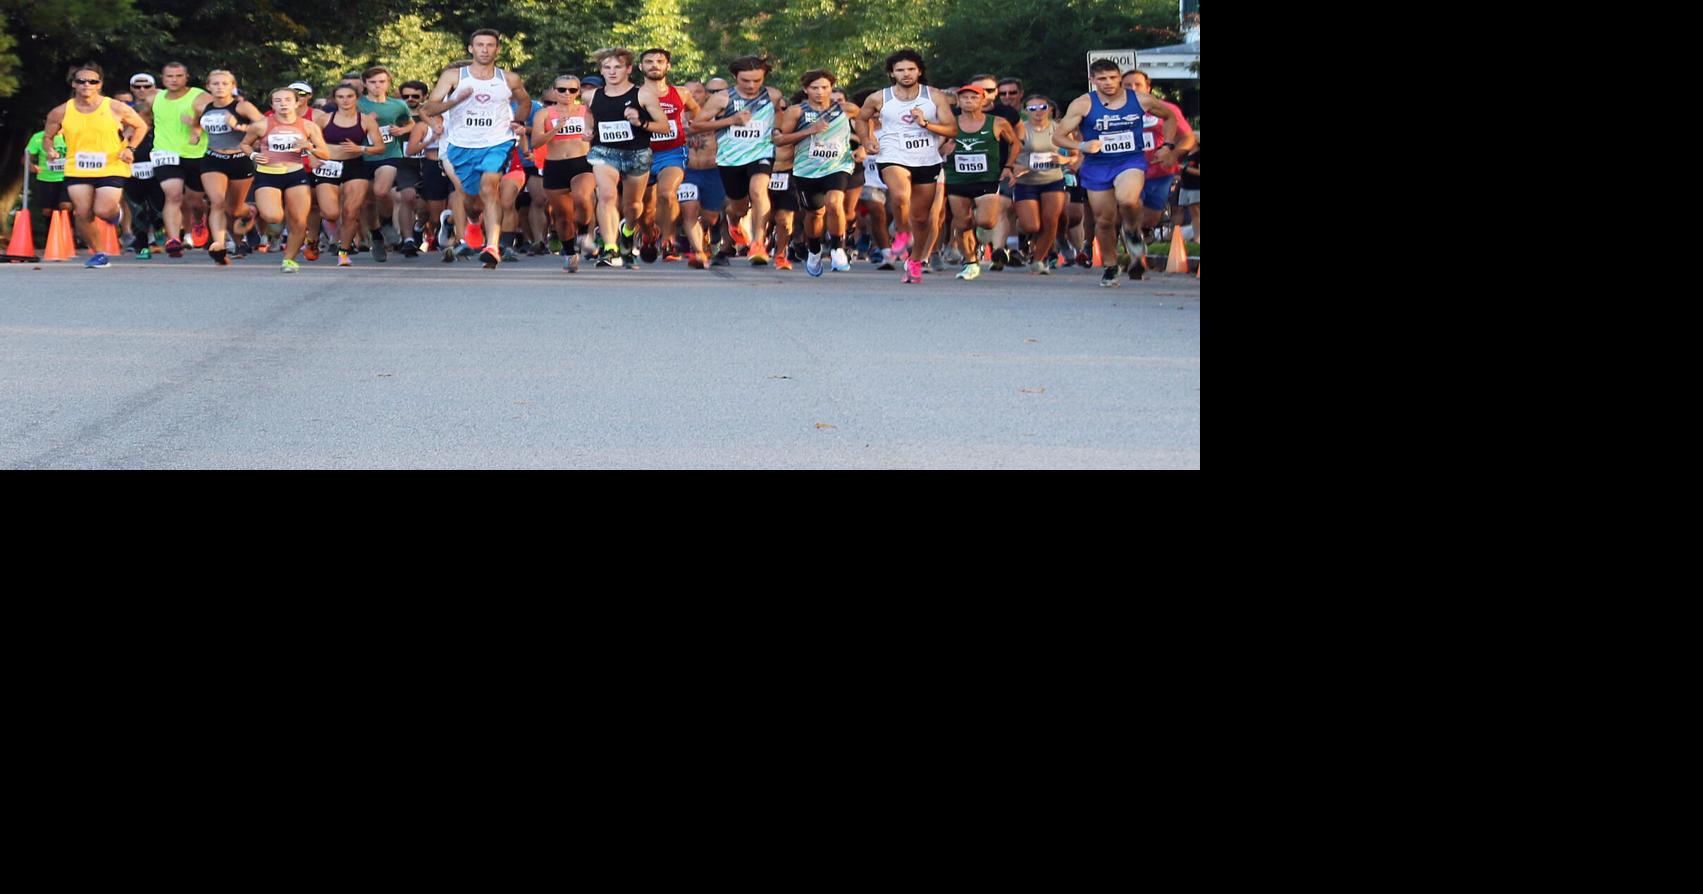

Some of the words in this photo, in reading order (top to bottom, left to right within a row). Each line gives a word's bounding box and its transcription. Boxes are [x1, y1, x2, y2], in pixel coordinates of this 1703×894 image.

[466, 118, 493, 127] 0160
[603, 130, 629, 140] 0069
[734, 129, 760, 138] 0073
[905, 138, 930, 149] 0071
[1105, 142, 1131, 151] 0048
[78, 161, 103, 169] 0190
[155, 157, 175, 166] 0211
[959, 162, 984, 171] 0159
[315, 167, 338, 177] 0154
[770, 181, 784, 189] 157
